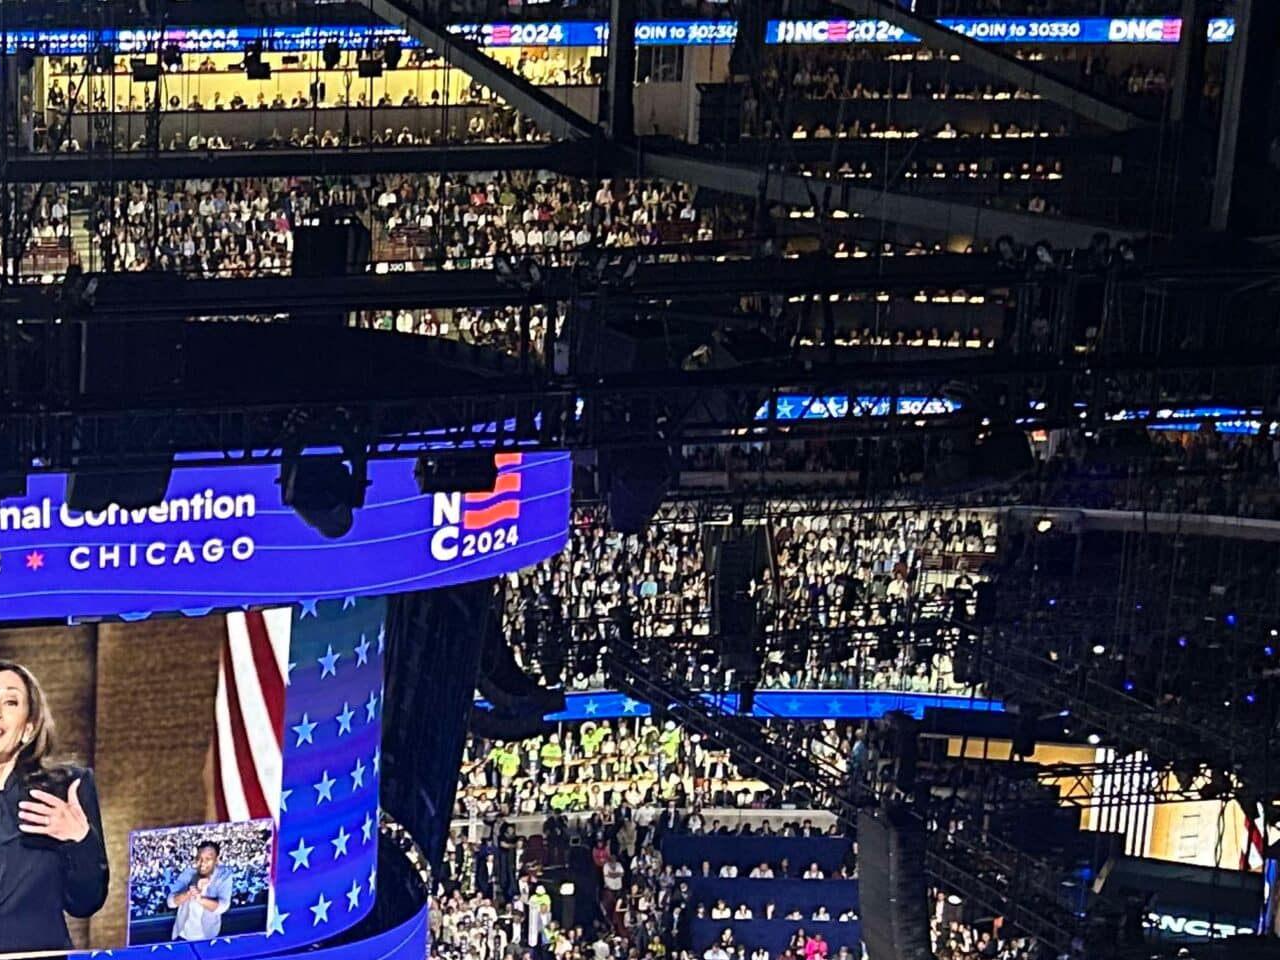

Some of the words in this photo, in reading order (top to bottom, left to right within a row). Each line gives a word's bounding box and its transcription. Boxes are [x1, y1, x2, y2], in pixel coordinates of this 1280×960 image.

[511, 24, 564, 44] 2024
[634, 26, 667, 39] OIN
[669, 26, 686, 39] to
[1009, 23, 1027, 37] to
[1028, 22, 1081, 38] 30330
[461, 525, 520, 558] 2024
[69, 536, 256, 571] CHICAGO
